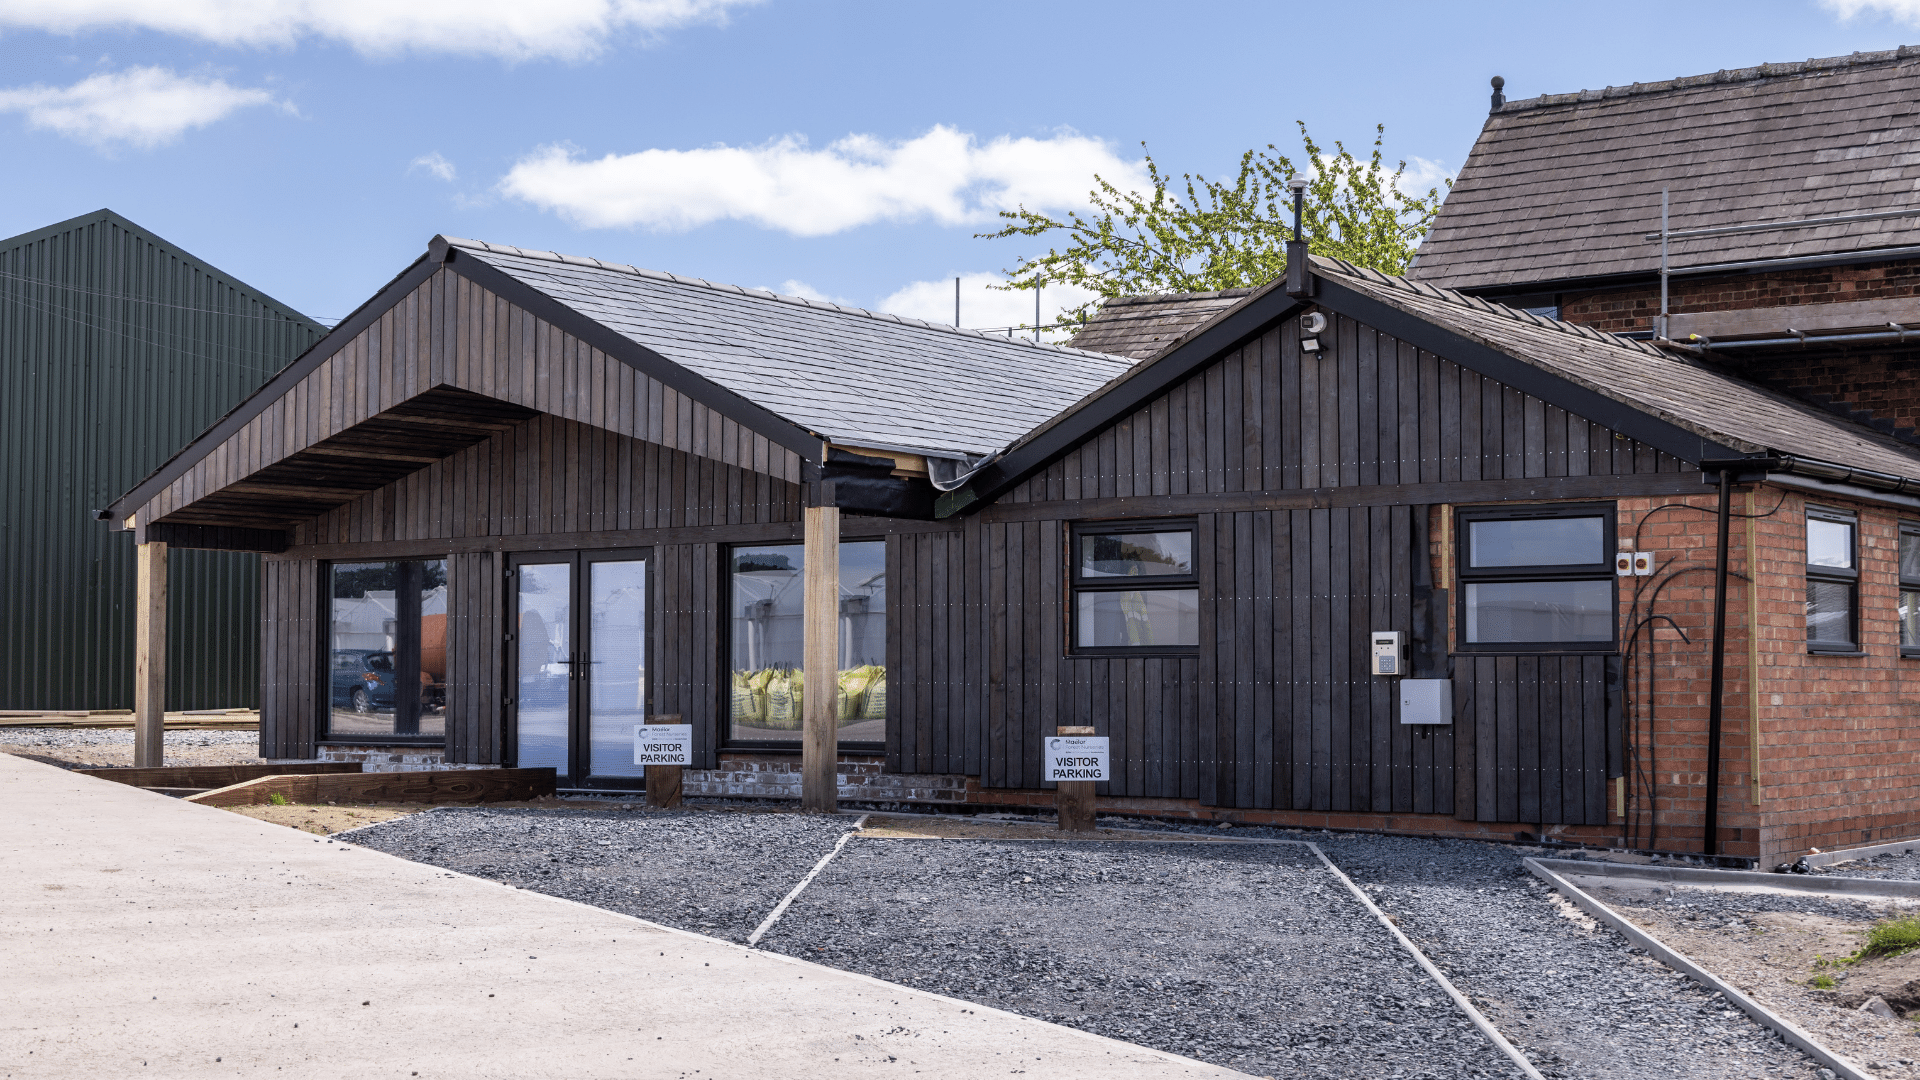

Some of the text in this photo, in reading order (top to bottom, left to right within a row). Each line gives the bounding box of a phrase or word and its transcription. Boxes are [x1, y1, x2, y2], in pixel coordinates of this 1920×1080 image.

[643, 743, 682, 752] VISITOR
[640, 754, 685, 763] PARKING
[1055, 757, 1099, 767] VISITOR
[1053, 769, 1102, 779] PARKING
